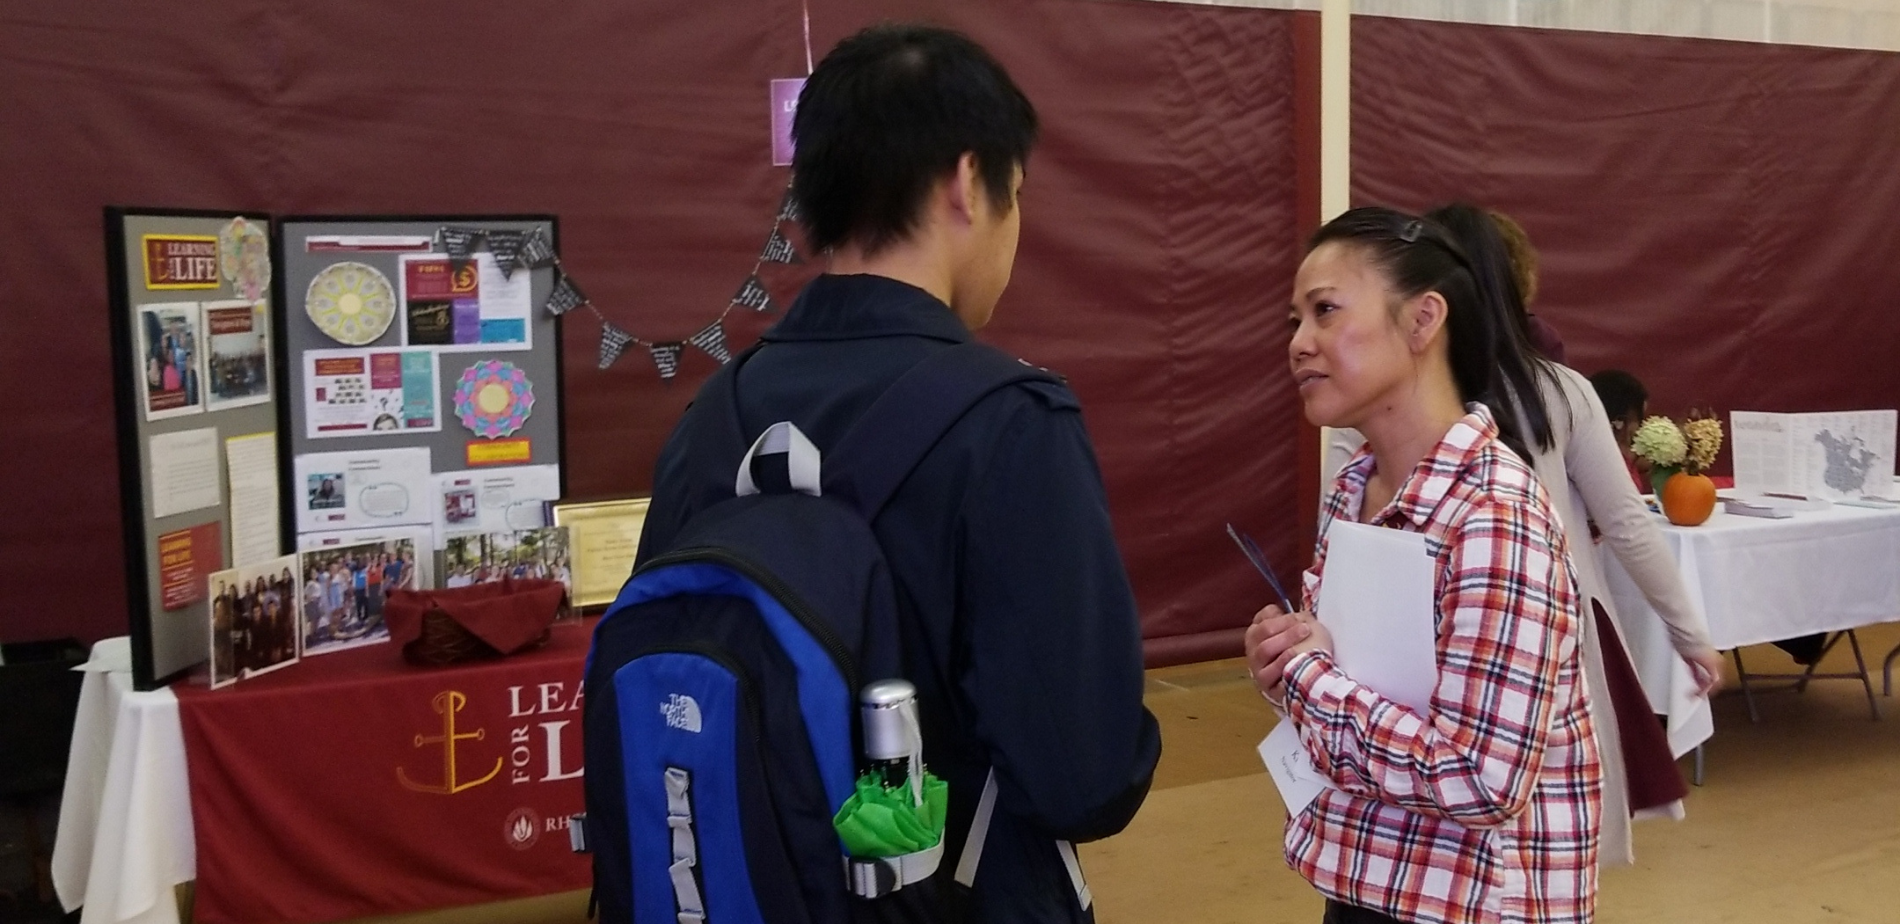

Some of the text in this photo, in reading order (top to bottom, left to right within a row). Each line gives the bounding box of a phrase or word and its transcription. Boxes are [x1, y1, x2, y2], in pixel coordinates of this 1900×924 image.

[168, 242, 215, 255] LEARNING
[175, 256, 217, 280] LIFE
[511, 724, 530, 785] FOR
